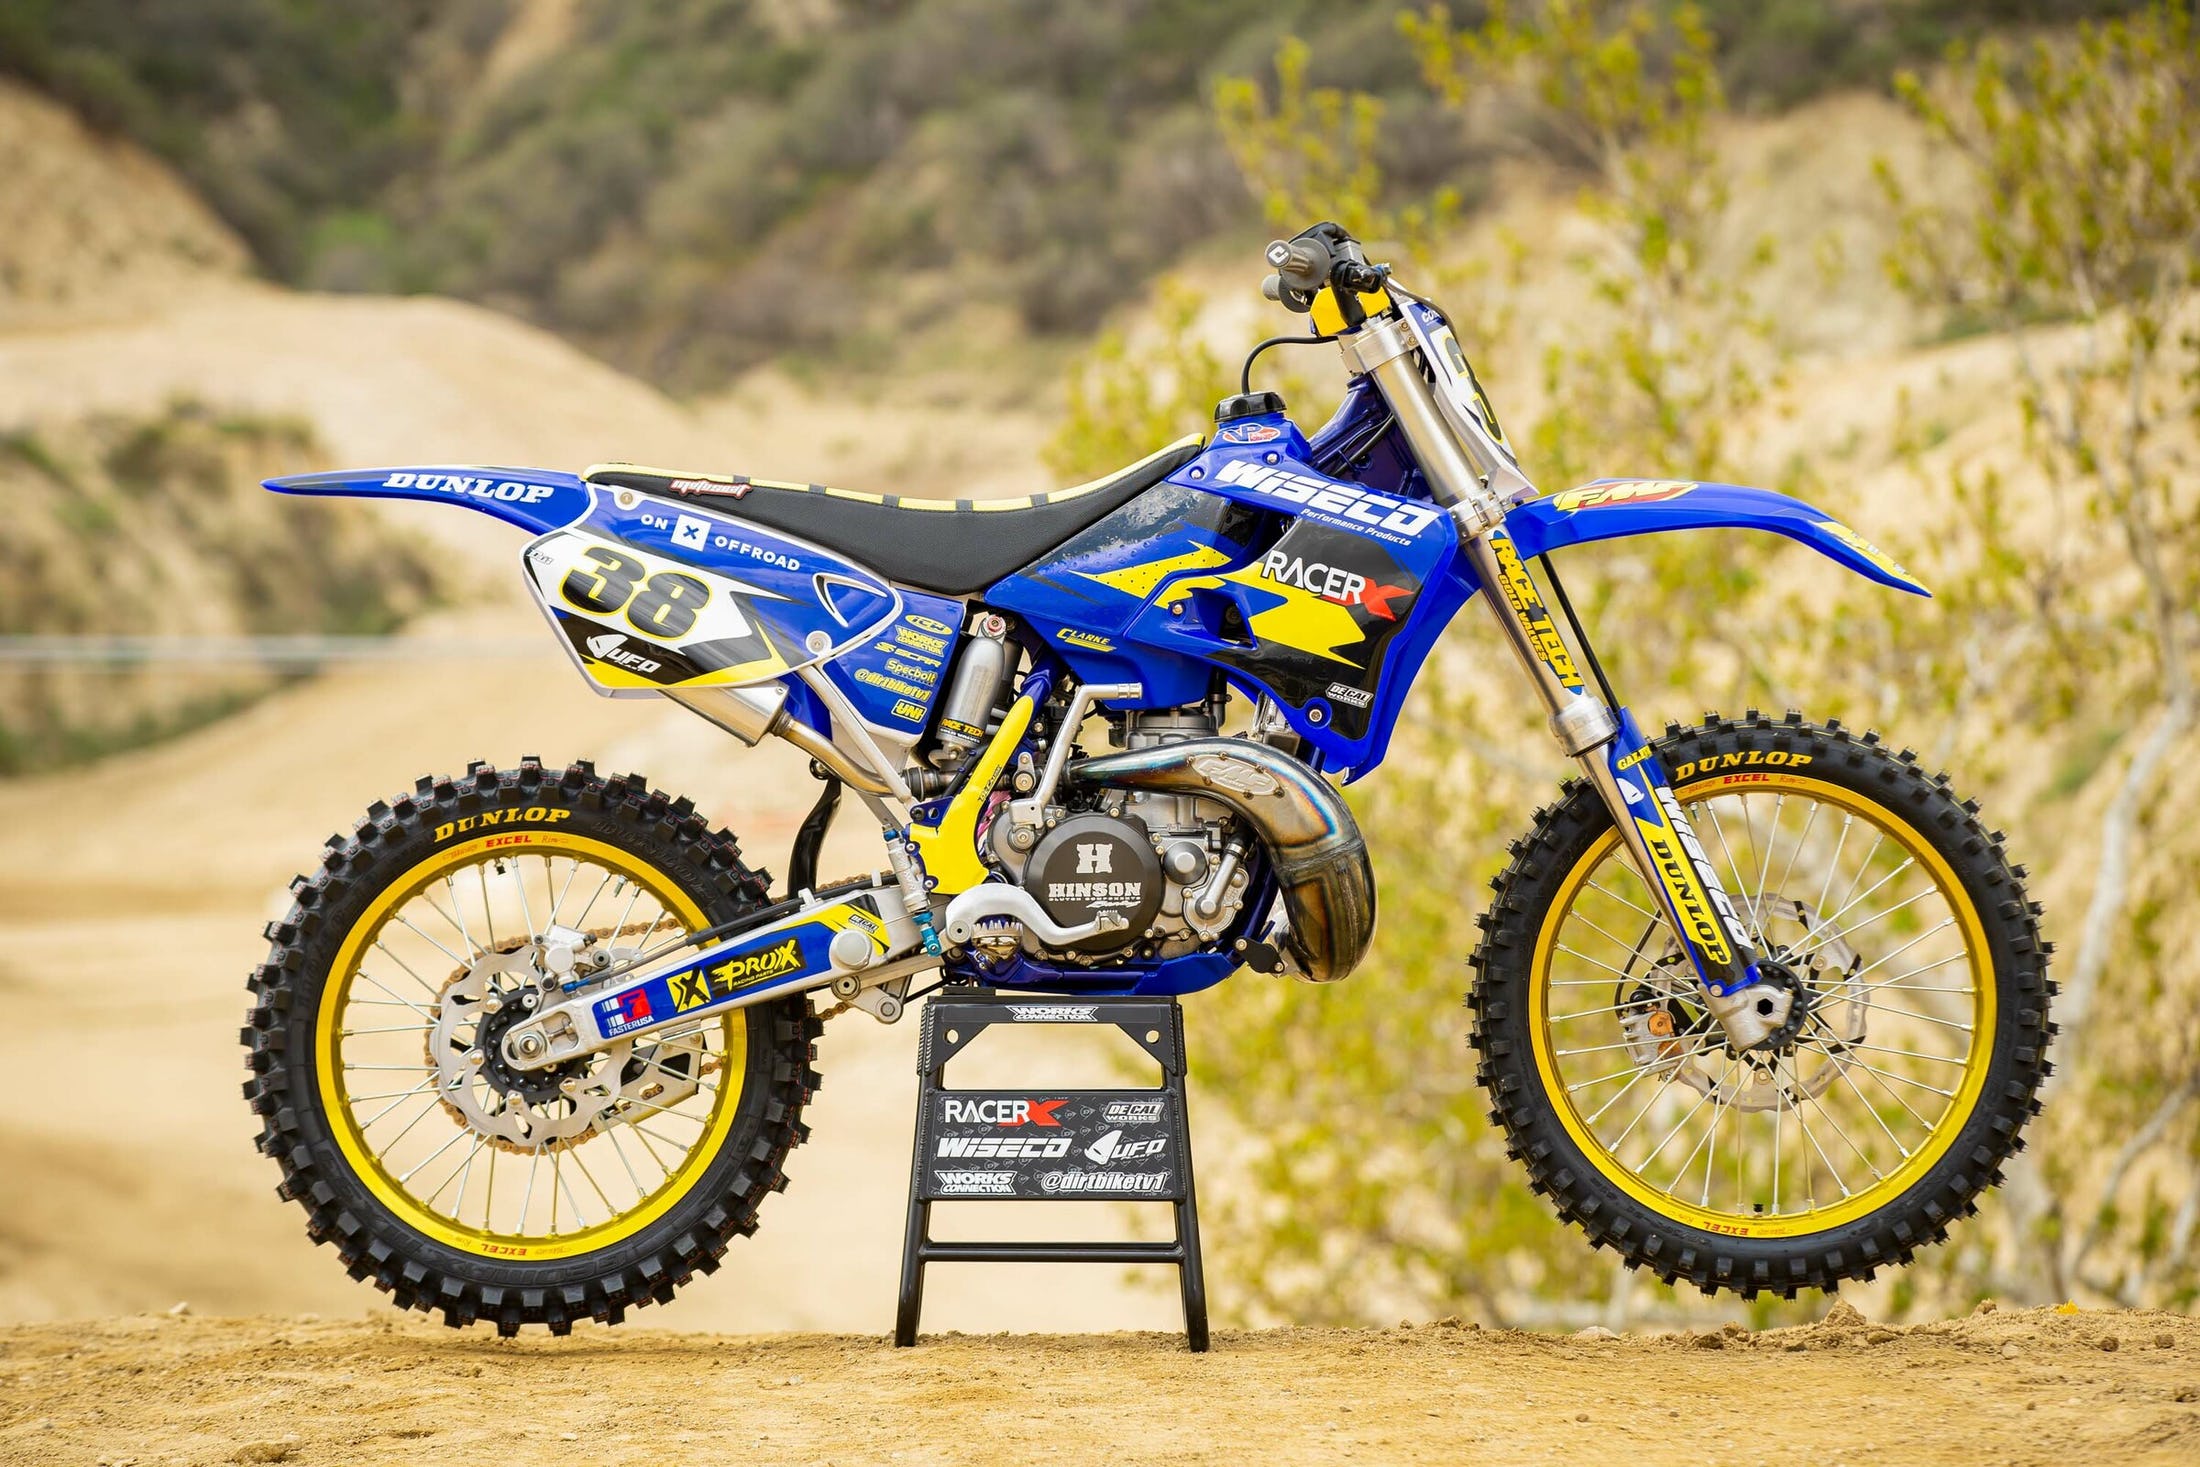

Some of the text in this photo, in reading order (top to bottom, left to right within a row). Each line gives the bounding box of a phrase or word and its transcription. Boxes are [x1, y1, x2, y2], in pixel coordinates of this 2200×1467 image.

[382, 473, 554, 503] DUNLOP
[1556, 482, 1698, 511] FMF
[1302, 508, 1412, 546] Performance Products
[641, 514, 668, 530] ON
[714, 536, 801, 571] OFFROAD
[559, 547, 713, 641] 38
[1489, 538, 1584, 688] RACE TECH
[1498, 574, 1549, 662] GOLD VALVES
[606, 649, 661, 673] UFO
[888, 659, 937, 683] Specbolt
[1675, 751, 1812, 781] DUNLOP
[1723, 774, 1770, 784] EXCEL
[434, 807, 571, 843] DUNLOP
[485, 835, 532, 848] EXCEL
[1076, 843, 1113, 873] H
[1049, 882, 1141, 897] HINSON
[1651, 839, 1731, 965] DUNLOP
[1012, 1006, 1093, 1015] WORKS
[1108, 1104, 1161, 1115] DECAL
[1110, 1139, 1166, 1158] UFO
[942, 1173, 1014, 1184] WORKS
[942, 1183, 1013, 1193] CONNECTION
[1042, 1172, 1167, 1193] @dirtbiketv1
[1703, 1221, 1749, 1236] EXCEL
[480, 1242, 527, 1256] EXCEL
